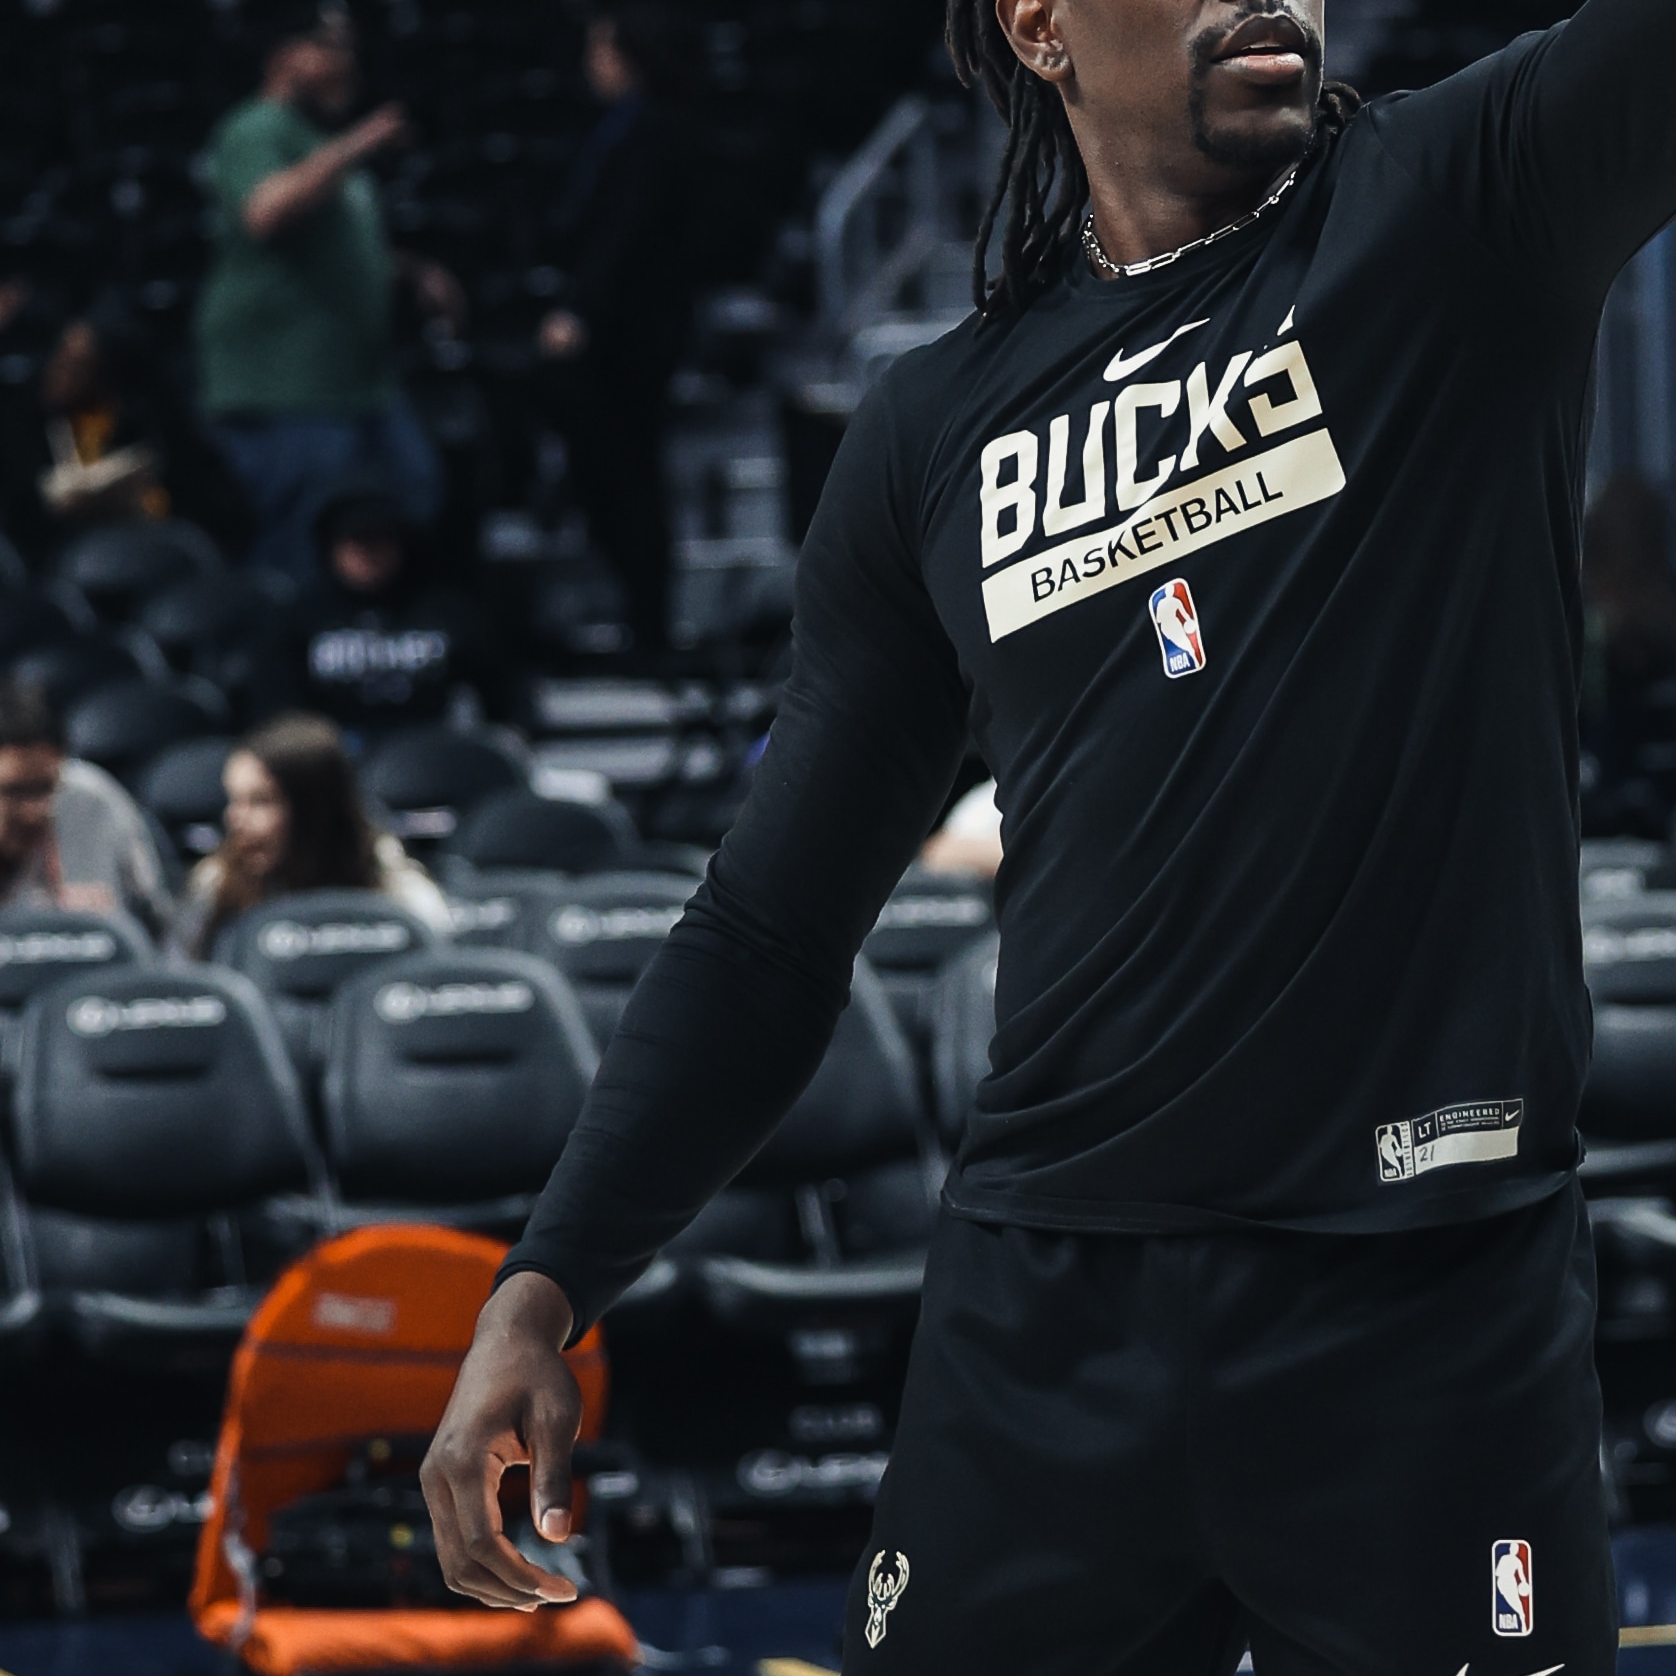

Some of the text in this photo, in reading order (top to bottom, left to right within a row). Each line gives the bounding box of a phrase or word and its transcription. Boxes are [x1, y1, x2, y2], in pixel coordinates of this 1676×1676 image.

[980, 338, 1323, 569] BUCKS
[1031, 471, 1284, 603] BASKETBALL
[1169, 651, 1191, 673] NBA
[1417, 1121, 1431, 1139] LT
[1499, 1613, 1518, 1629] NBA
